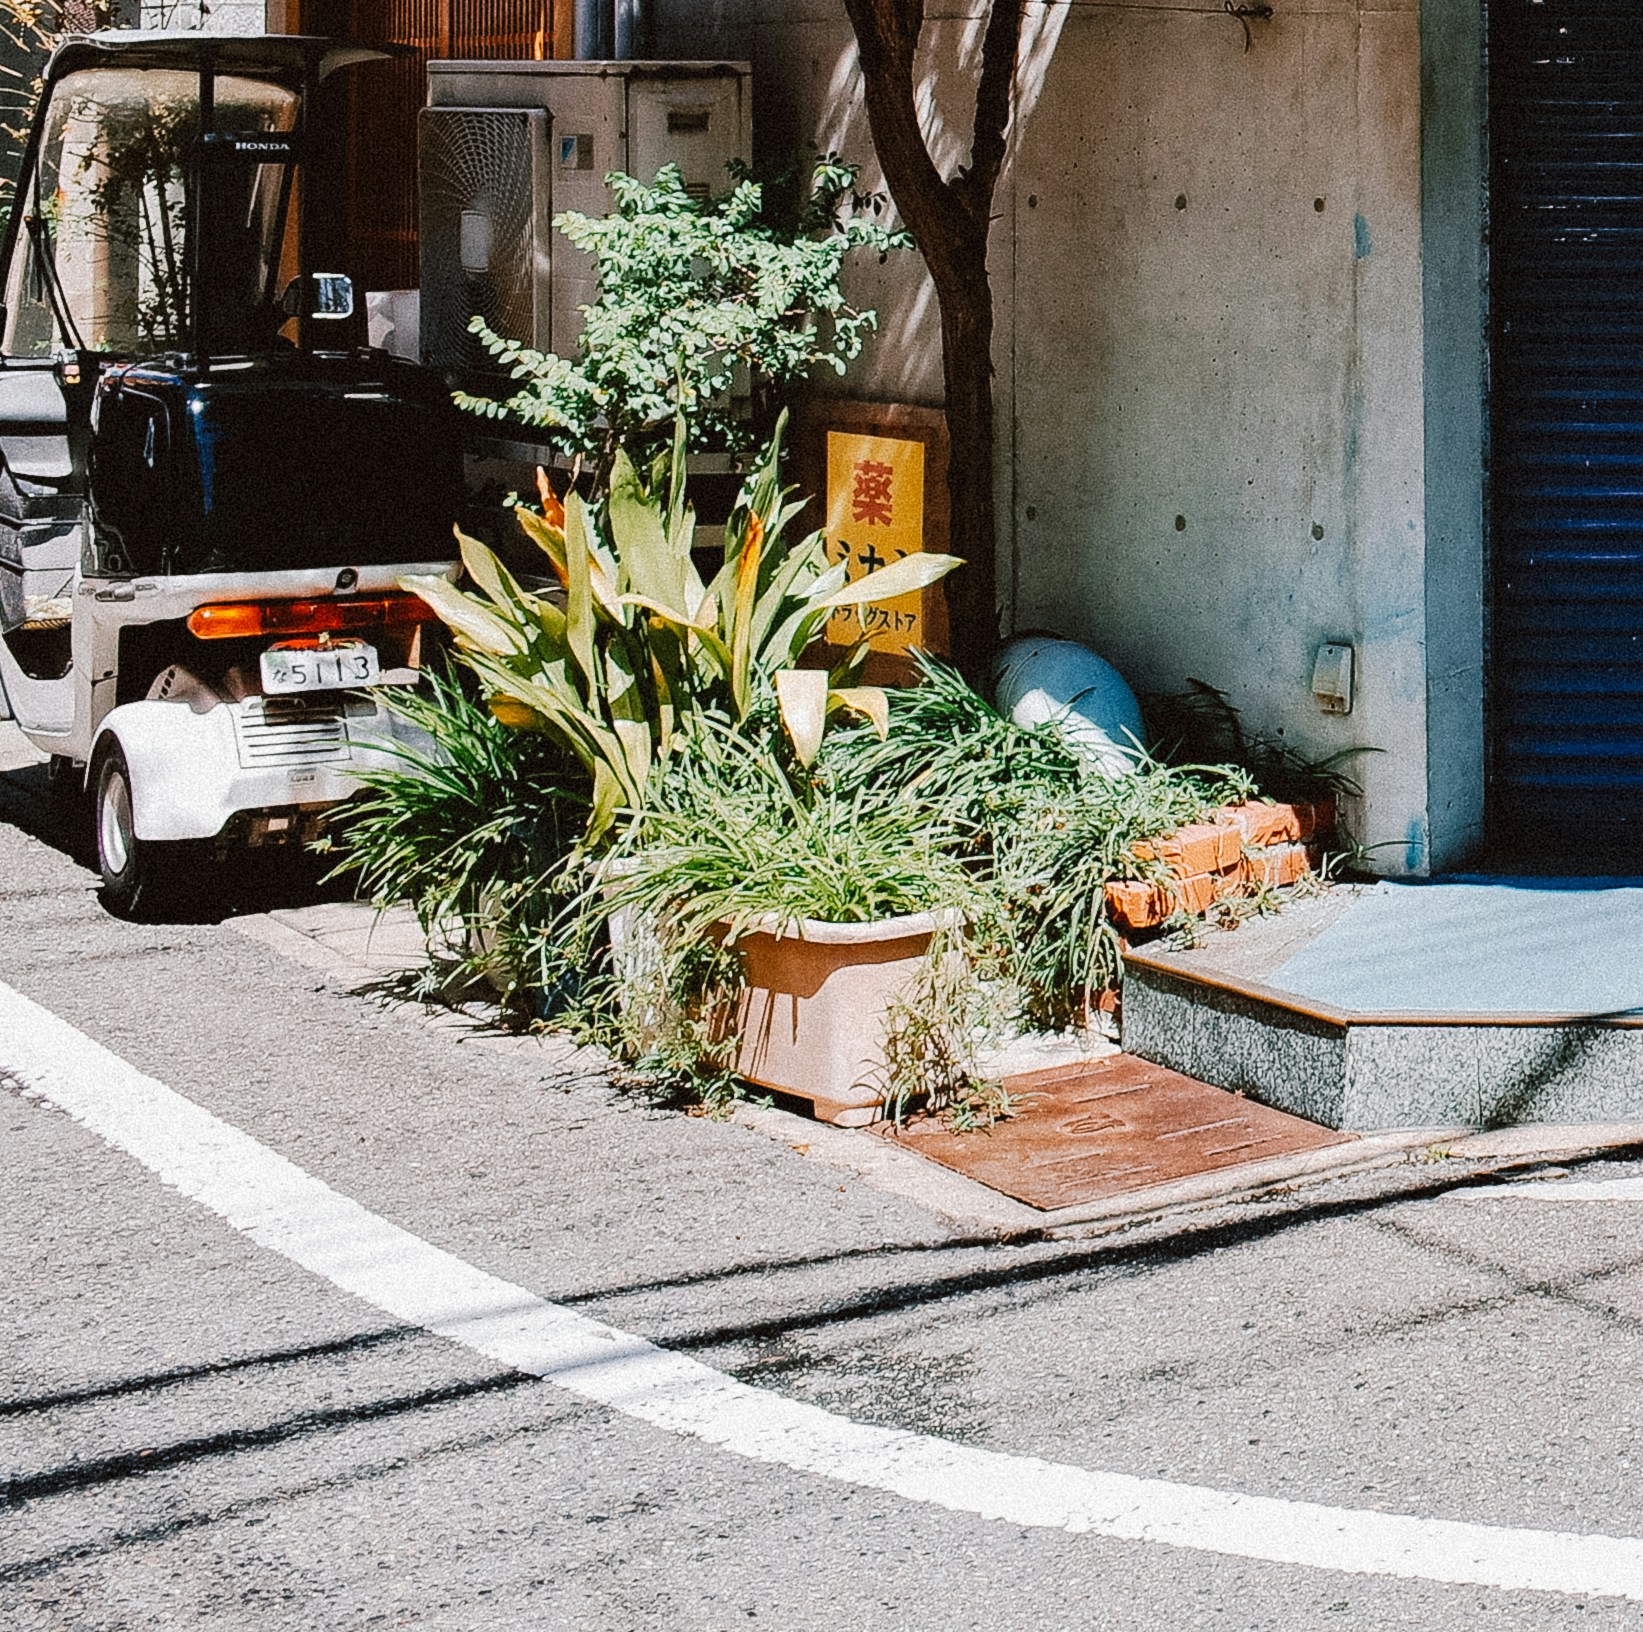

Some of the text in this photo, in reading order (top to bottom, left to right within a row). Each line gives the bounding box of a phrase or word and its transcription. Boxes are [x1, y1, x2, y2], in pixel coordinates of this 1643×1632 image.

[235, 142, 290, 150] HONDA
[853, 460, 893, 527] 薬
[292, 656, 369, 684] 5113
